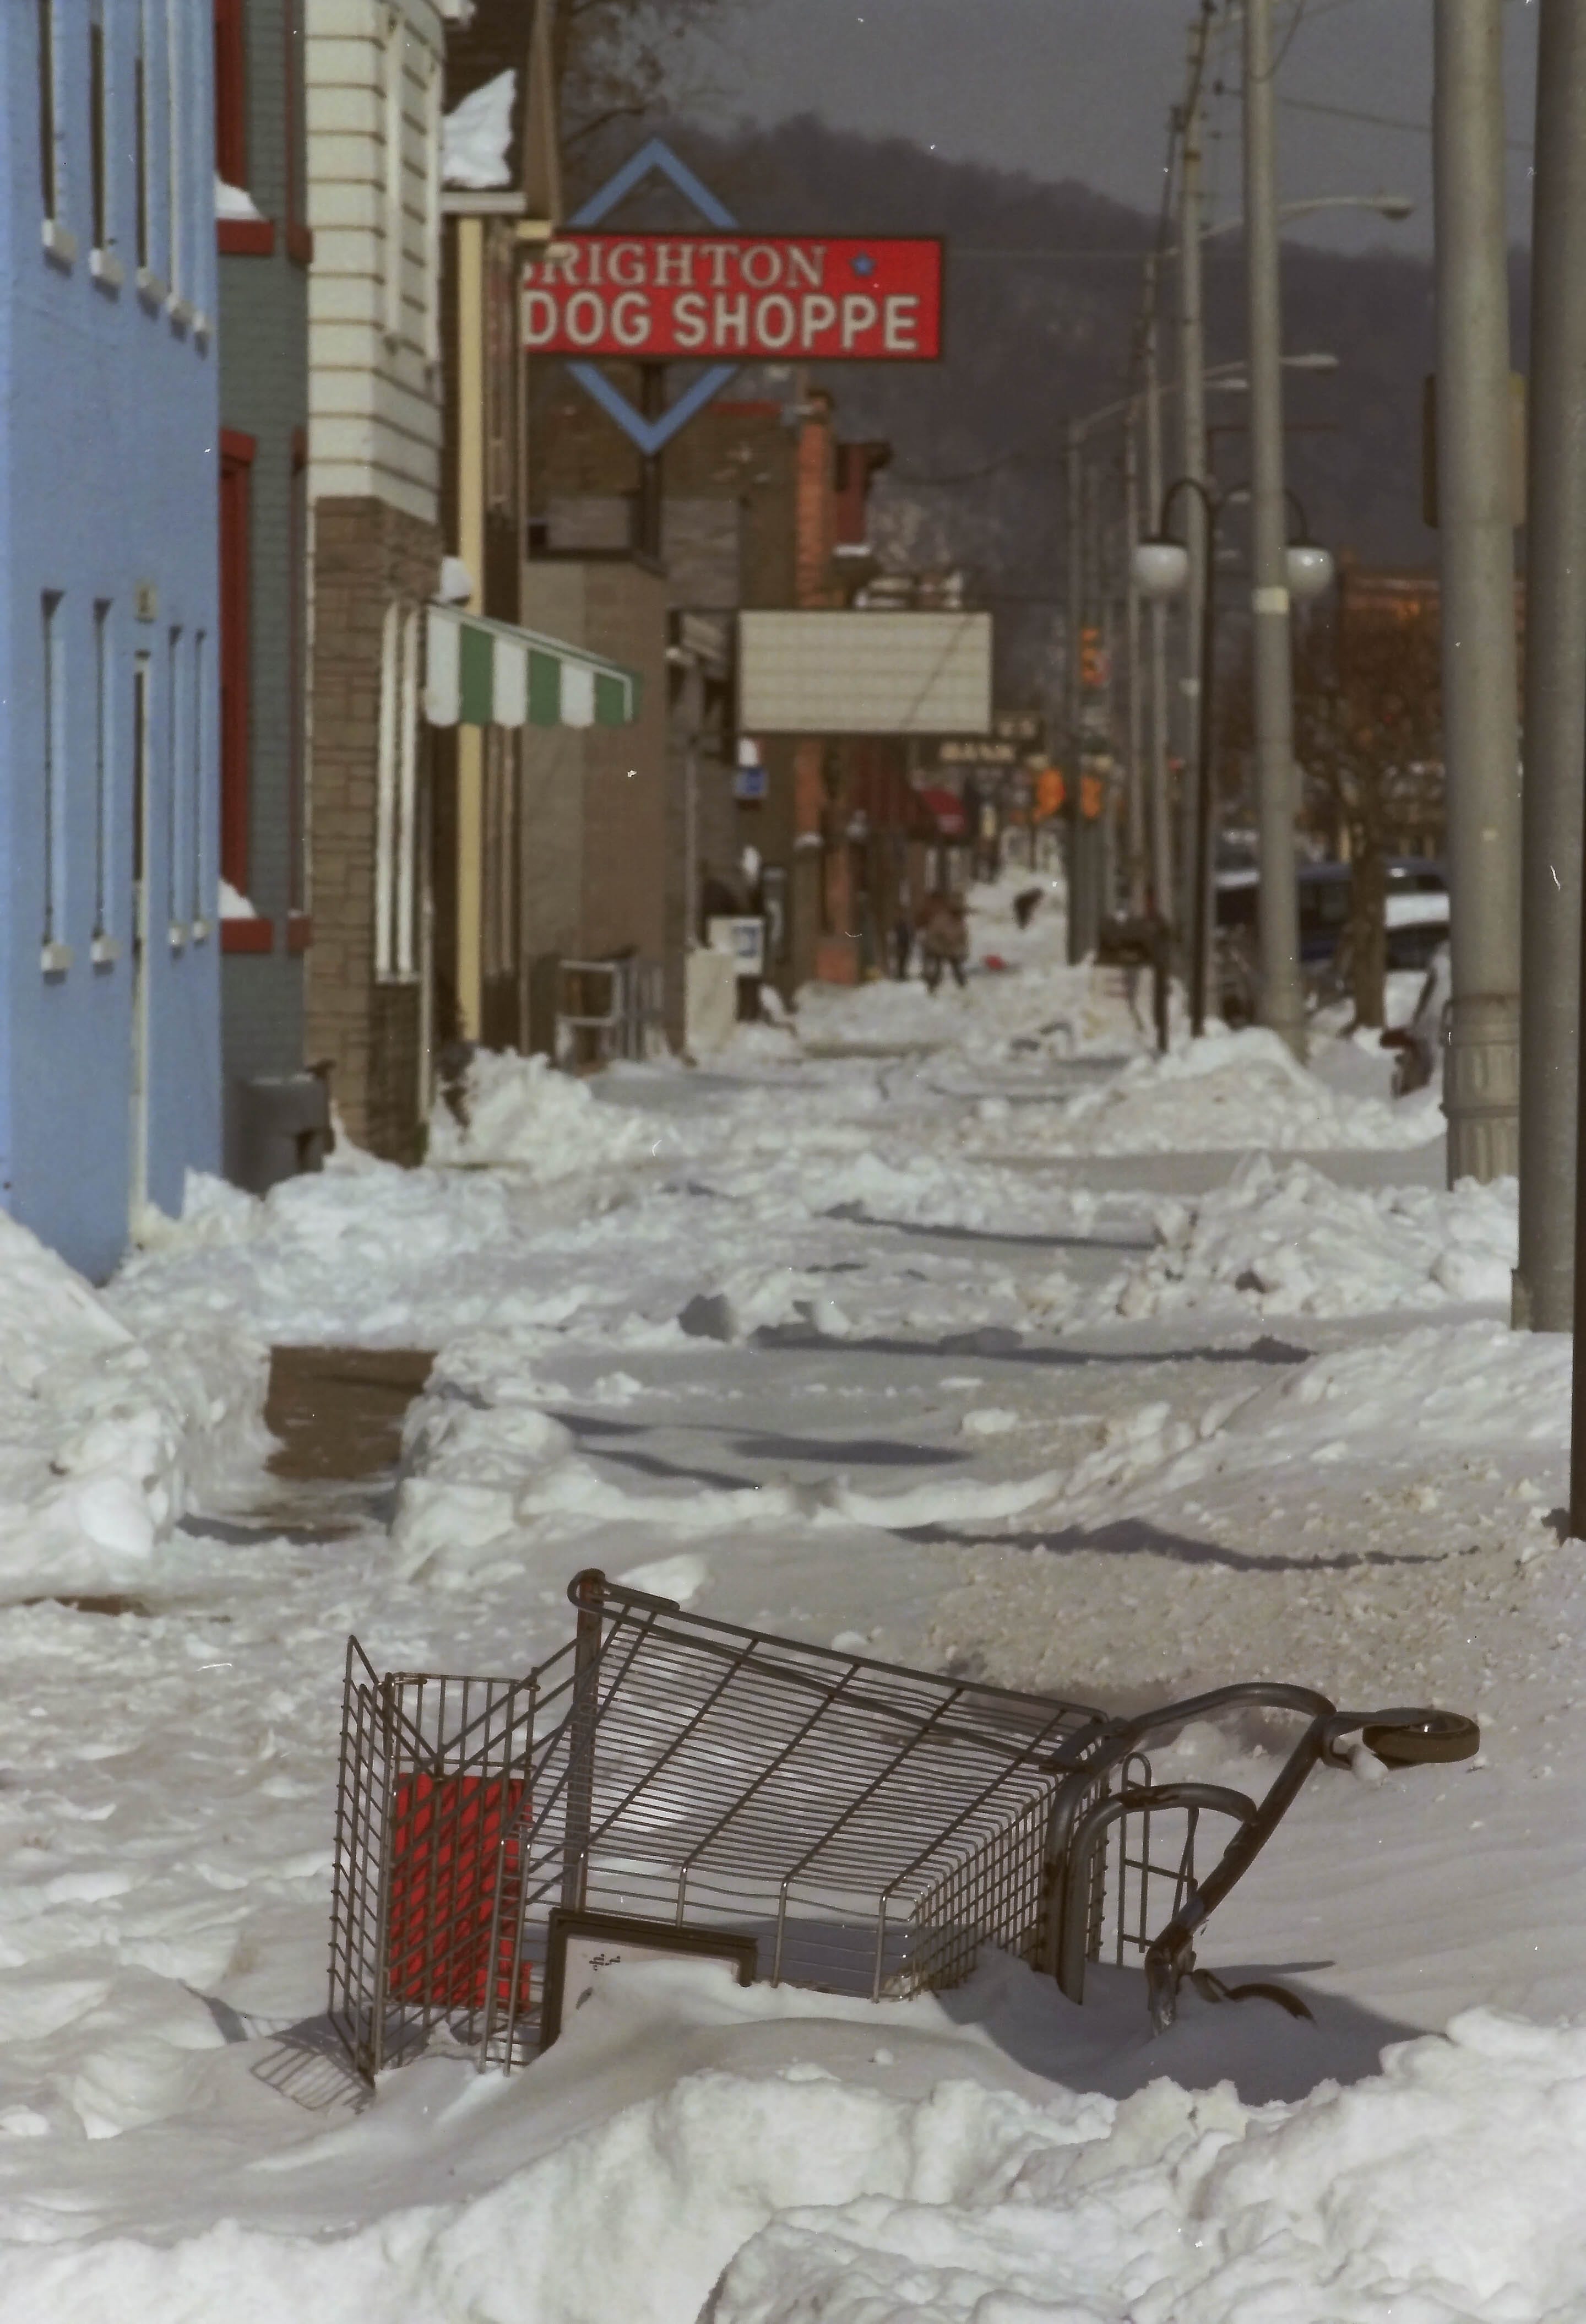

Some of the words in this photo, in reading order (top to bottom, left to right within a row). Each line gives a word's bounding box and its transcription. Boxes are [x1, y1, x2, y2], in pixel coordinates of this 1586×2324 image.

[523, 241, 826, 289] RIGHTON
[523, 289, 651, 347] DOG
[673, 292, 919, 351] SHOPPE
